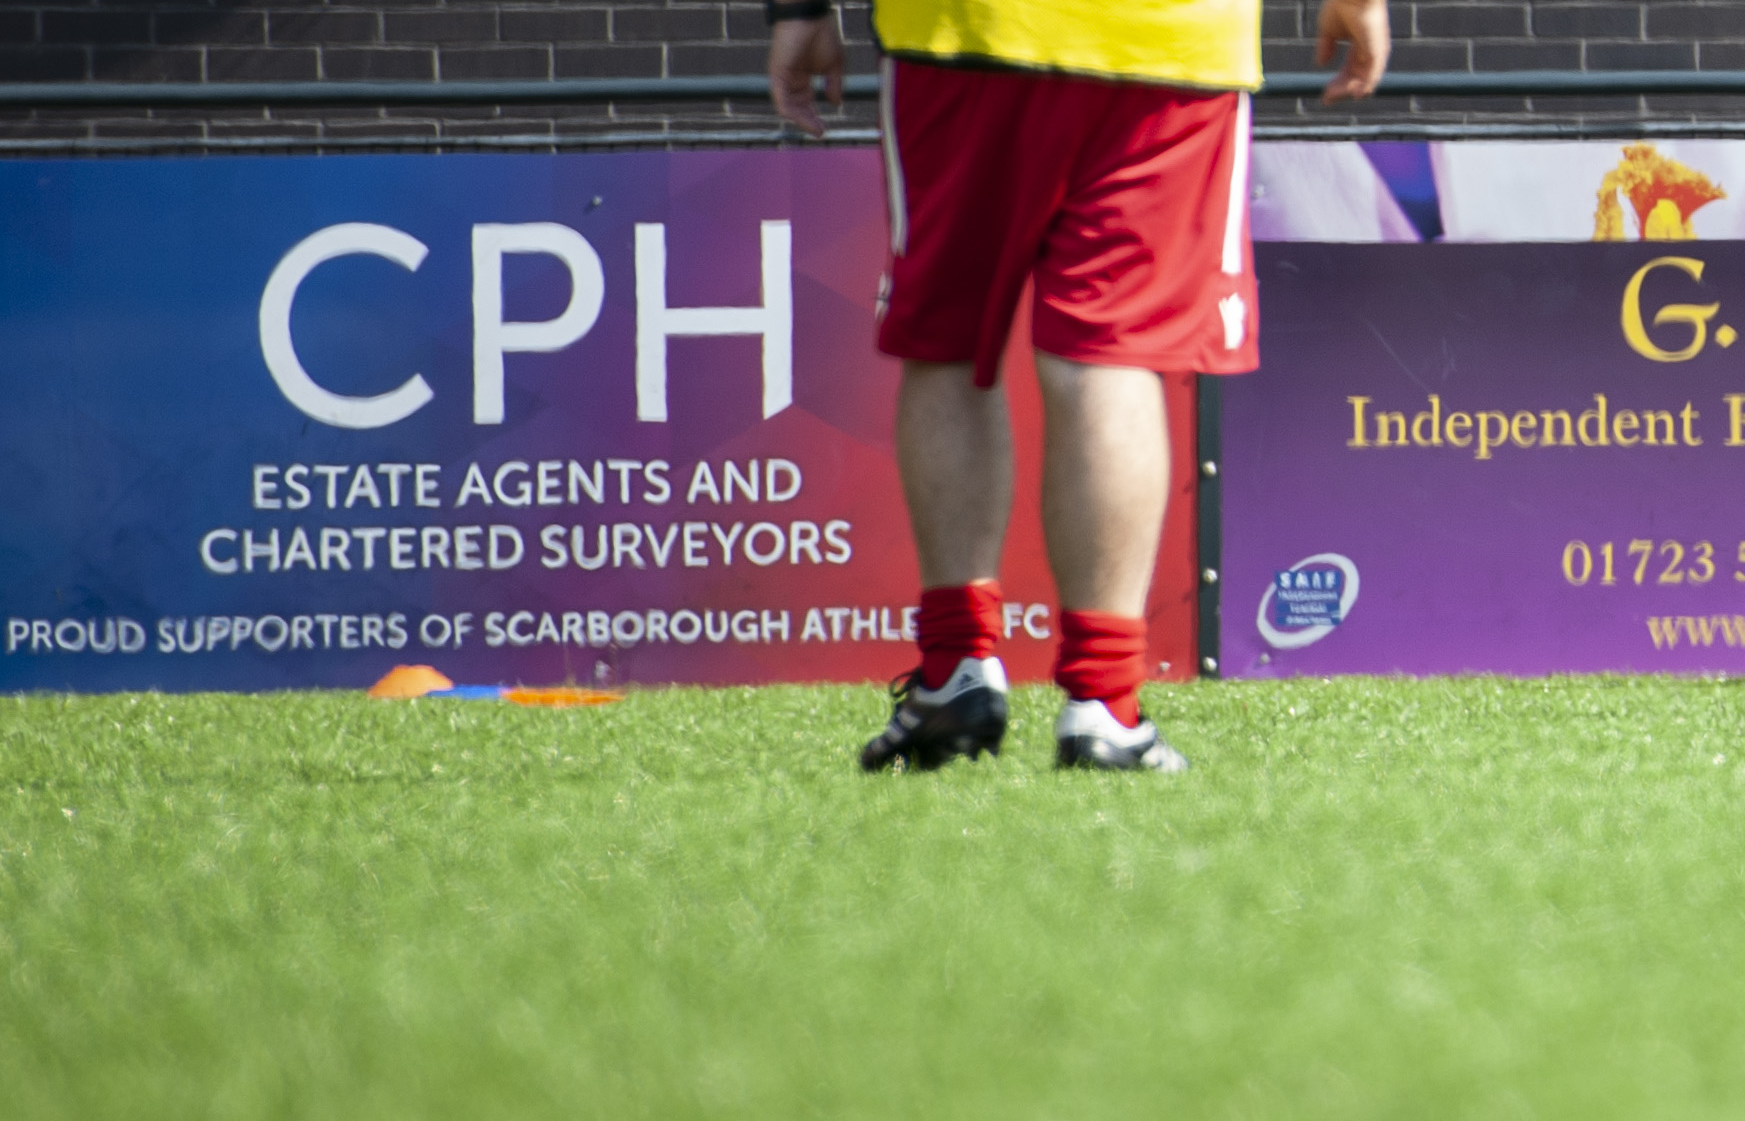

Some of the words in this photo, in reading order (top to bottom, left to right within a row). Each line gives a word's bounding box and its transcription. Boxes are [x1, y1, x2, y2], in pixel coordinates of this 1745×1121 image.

[259, 219, 793, 429] CPH
[1620, 256, 1738, 363] G.
[1347, 394, 1704, 459] Independent
[253, 463, 442, 511] ESTATE
[457, 459, 671, 507] AGENTS
[687, 457, 803, 503] AND
[201, 525, 524, 574] CHARTERED
[540, 520, 853, 570] SURVEYORS
[1562, 539, 1716, 586] 01723
[6, 618, 146, 654] PROUD
[158, 614, 409, 654] SUPPORTERS
[420, 612, 472, 650] OF
[484, 609, 790, 646] SCARBOROUGH
[800, 607, 922, 643] ATHLE
[1002, 603, 1052, 640] FC
